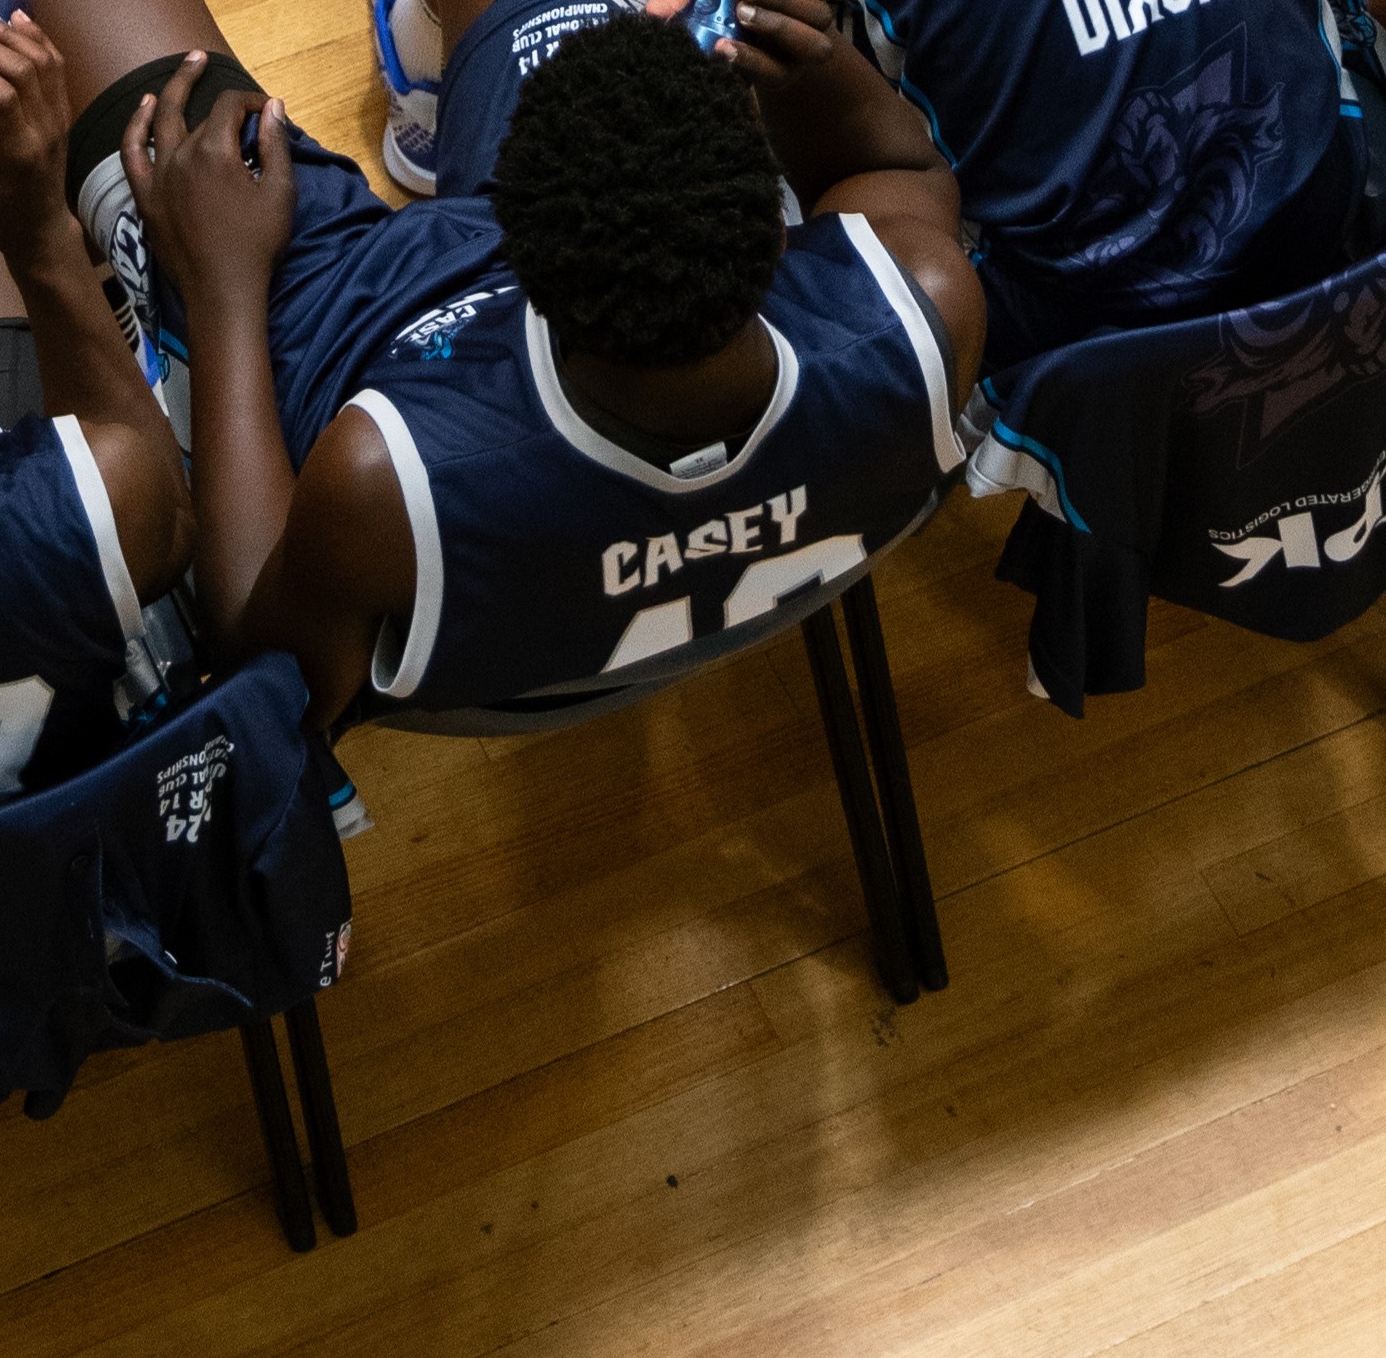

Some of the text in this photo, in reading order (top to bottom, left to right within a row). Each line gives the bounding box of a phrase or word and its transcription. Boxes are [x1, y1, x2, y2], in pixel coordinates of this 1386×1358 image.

[512, 30, 544, 54] CLUB
[1207, 500, 1291, 542] LOGISTICS
[601, 484, 807, 596] CASEY
[158, 772, 188, 798] CLUB
[160, 792, 181, 817] 14
